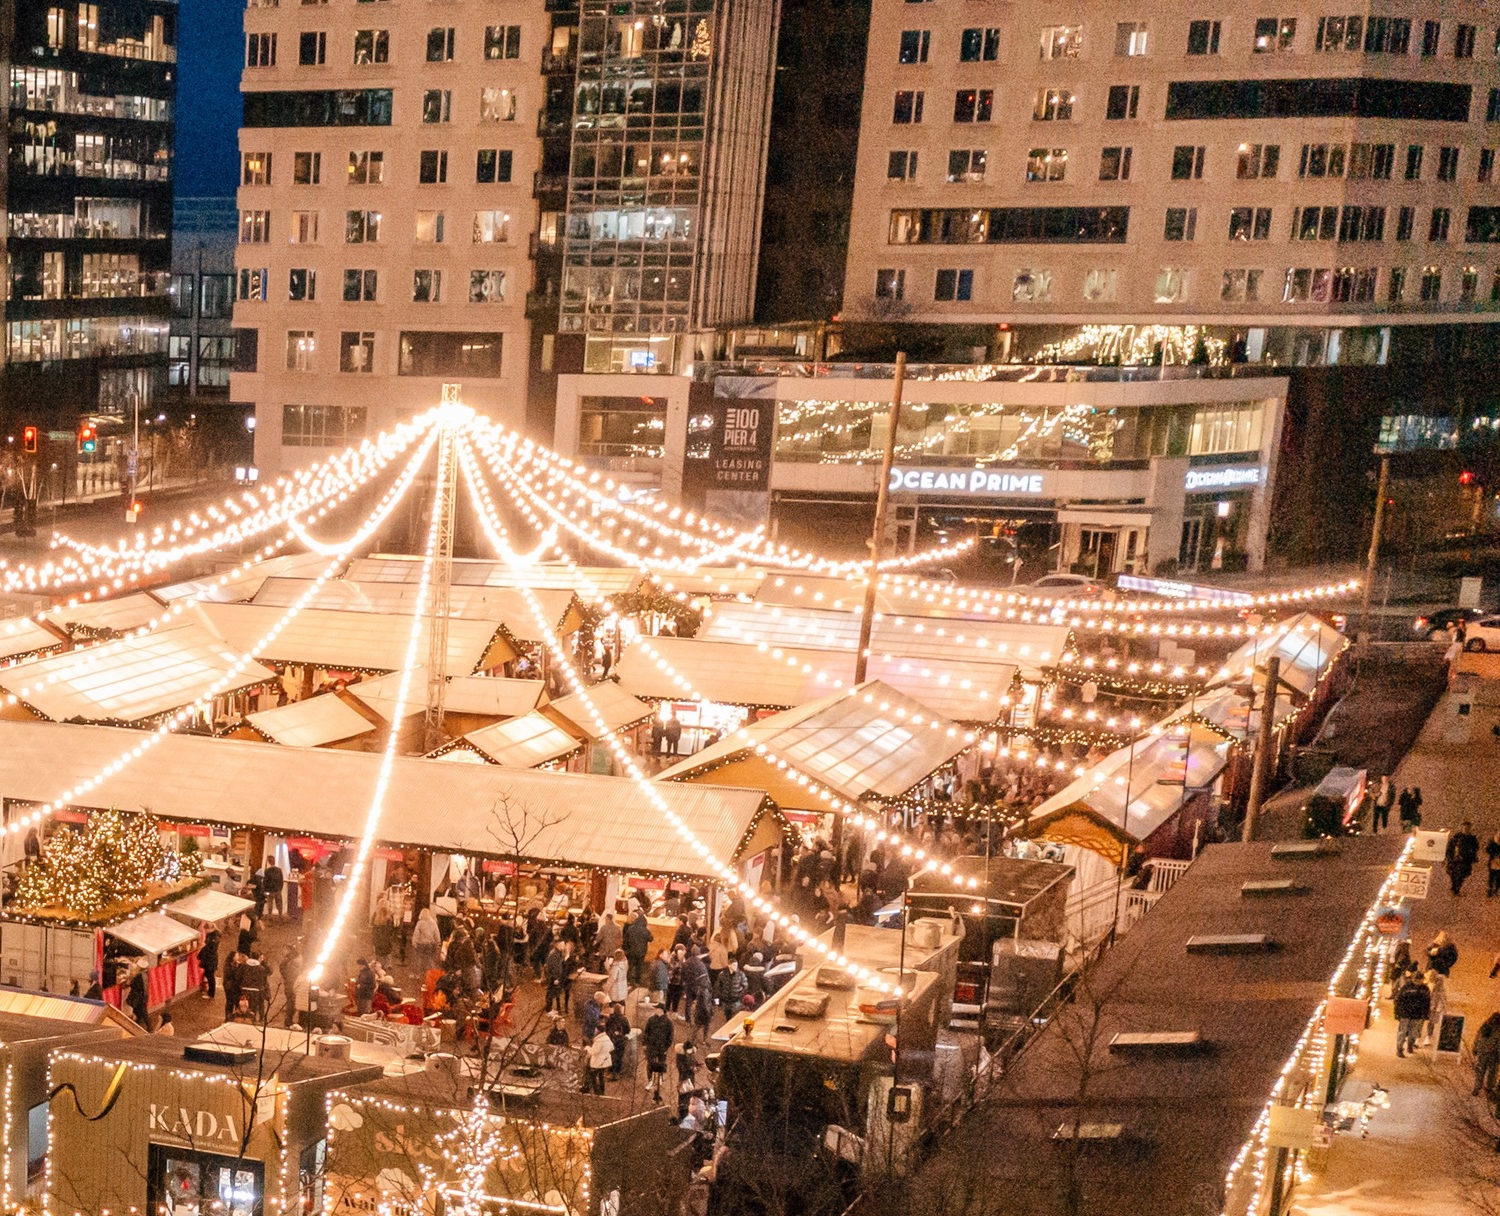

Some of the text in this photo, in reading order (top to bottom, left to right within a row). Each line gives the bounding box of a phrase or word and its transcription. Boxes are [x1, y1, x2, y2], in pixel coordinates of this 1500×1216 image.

[735, 408, 759, 430] 100
[724, 430, 757, 446] PIER 4
[716, 459, 762, 469] LEASING
[717, 471, 759, 481] CENTER
[970, 471, 1043, 492] PRIME
[149, 1103, 239, 1142] KADA
